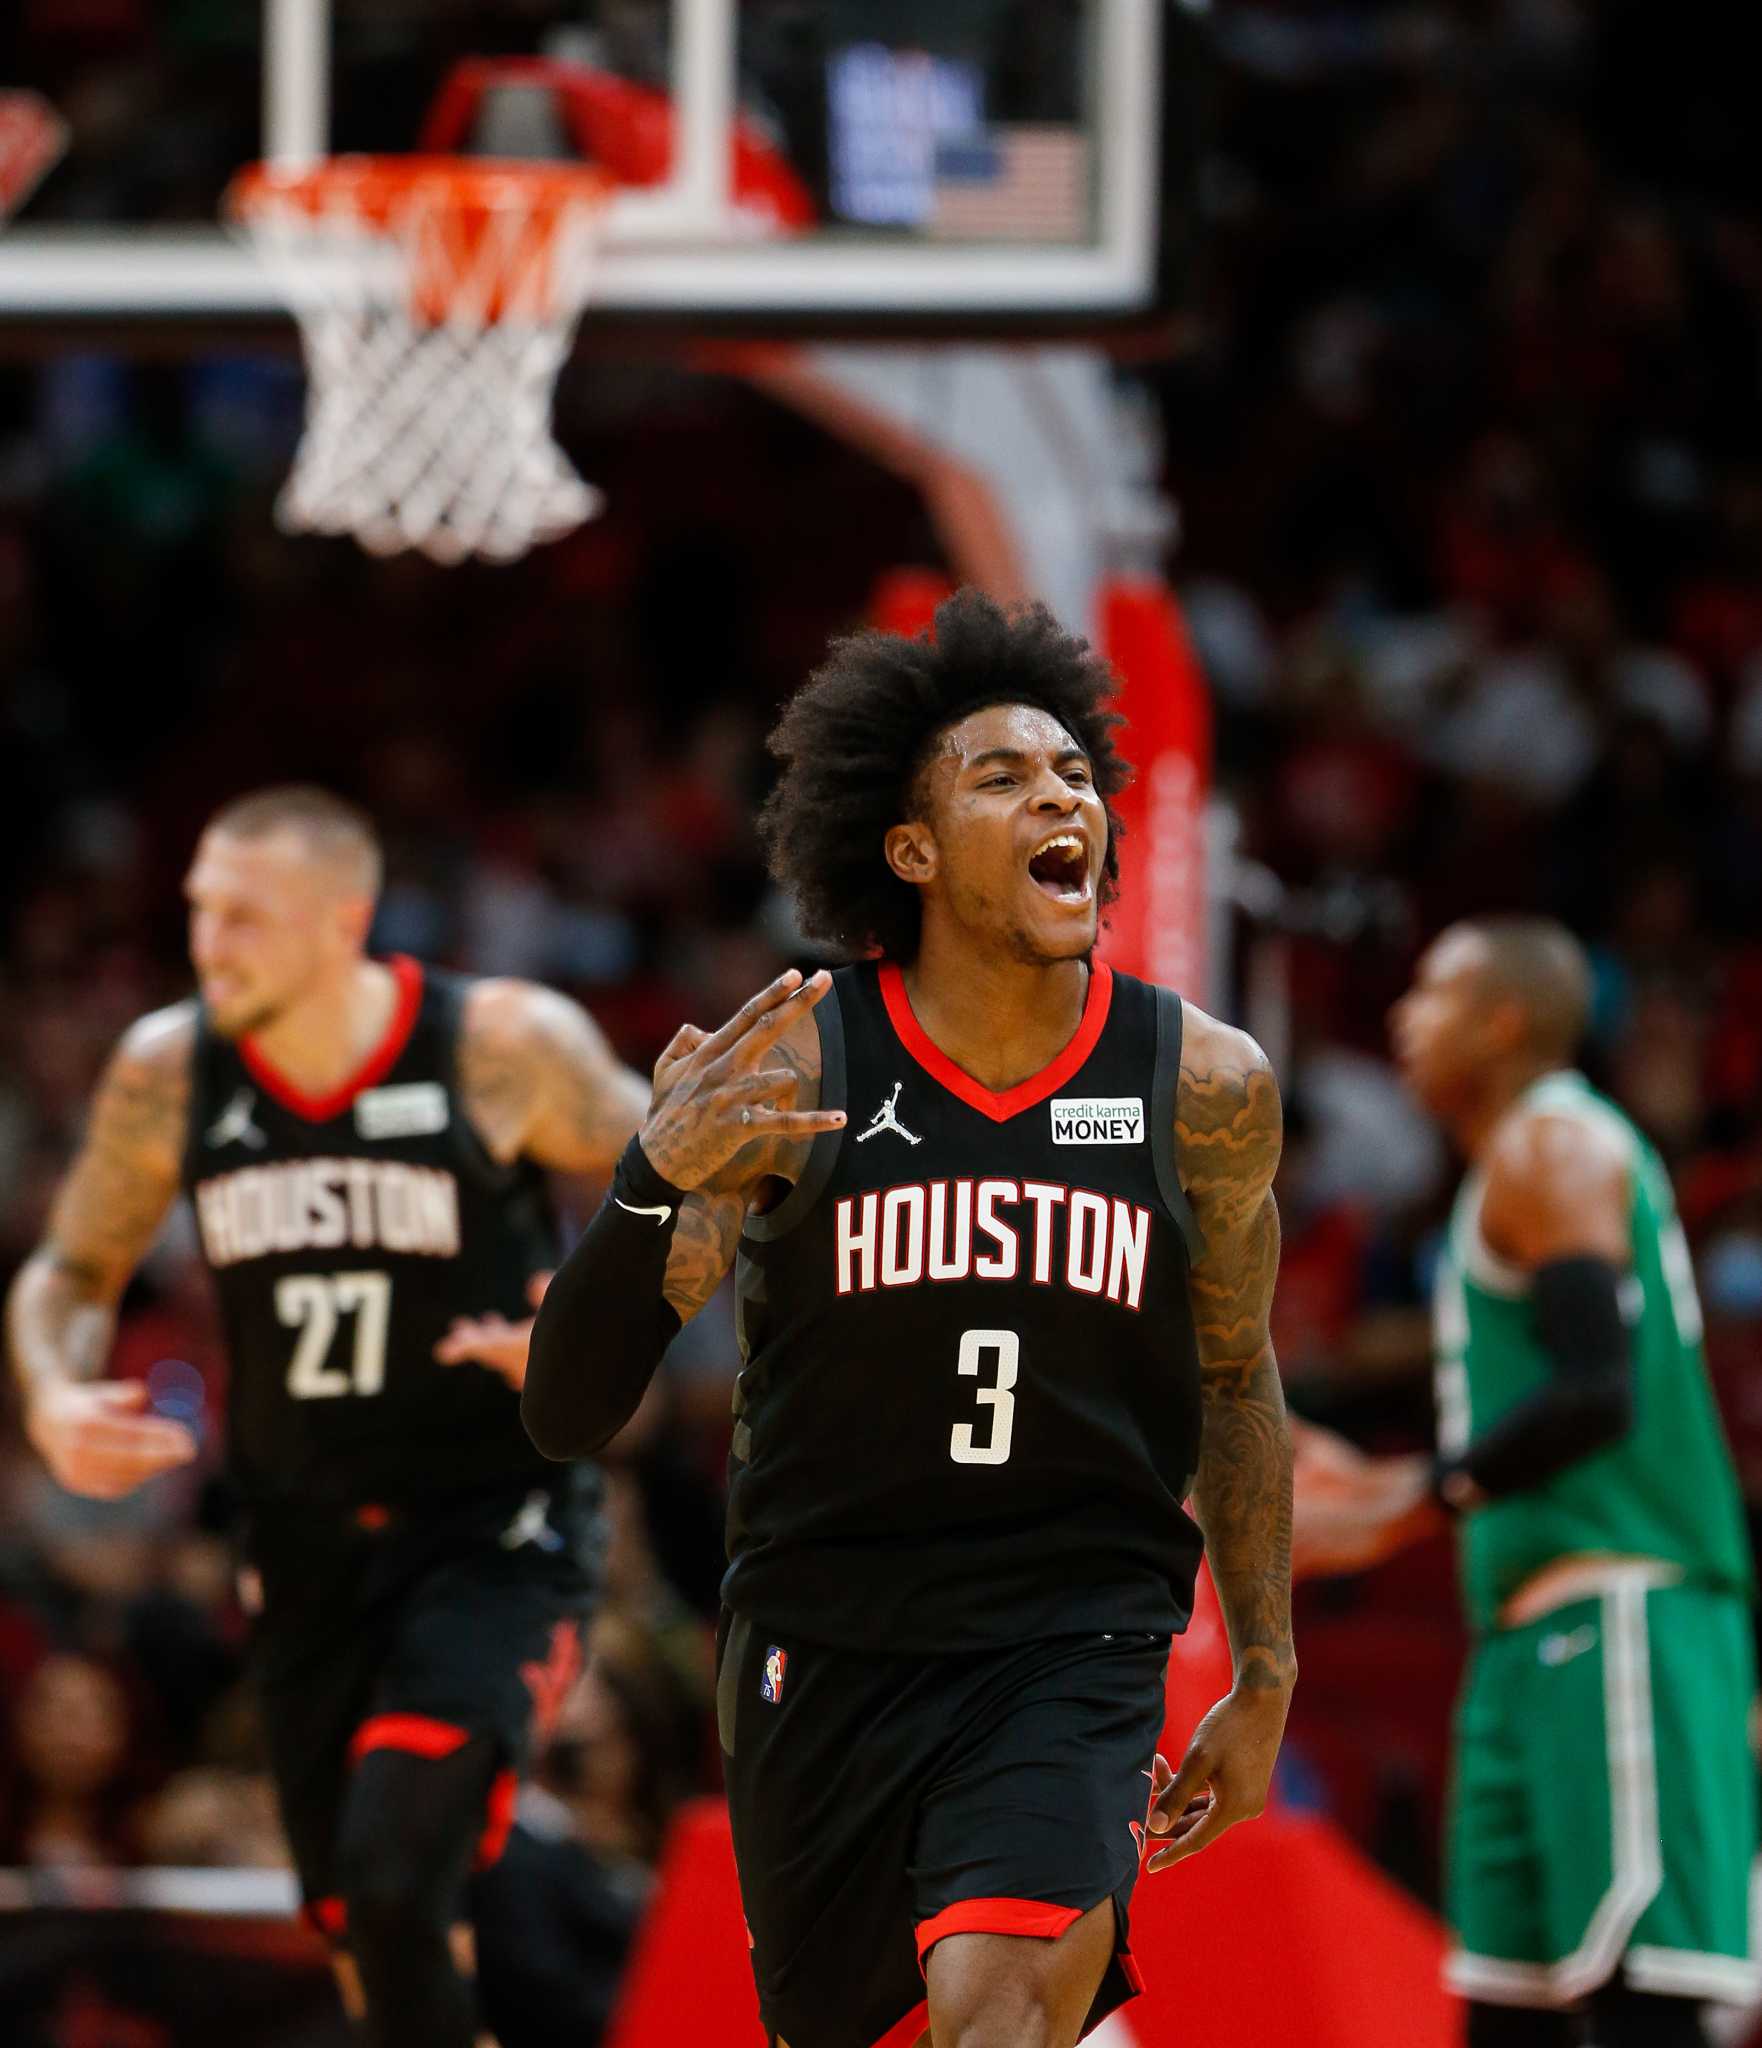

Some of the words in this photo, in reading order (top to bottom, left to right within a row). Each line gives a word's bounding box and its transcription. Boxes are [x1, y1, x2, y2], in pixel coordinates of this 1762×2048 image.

[1054, 1104, 1094, 1118] credit
[1096, 1104, 1140, 1117] karma
[1055, 1119, 1140, 1140] MONEY
[196, 1156, 461, 1268] HOUSTON
[834, 1177, 1152, 1312] HOUSTON
[274, 1271, 391, 1399] 27
[950, 1329, 1020, 1465] 3
